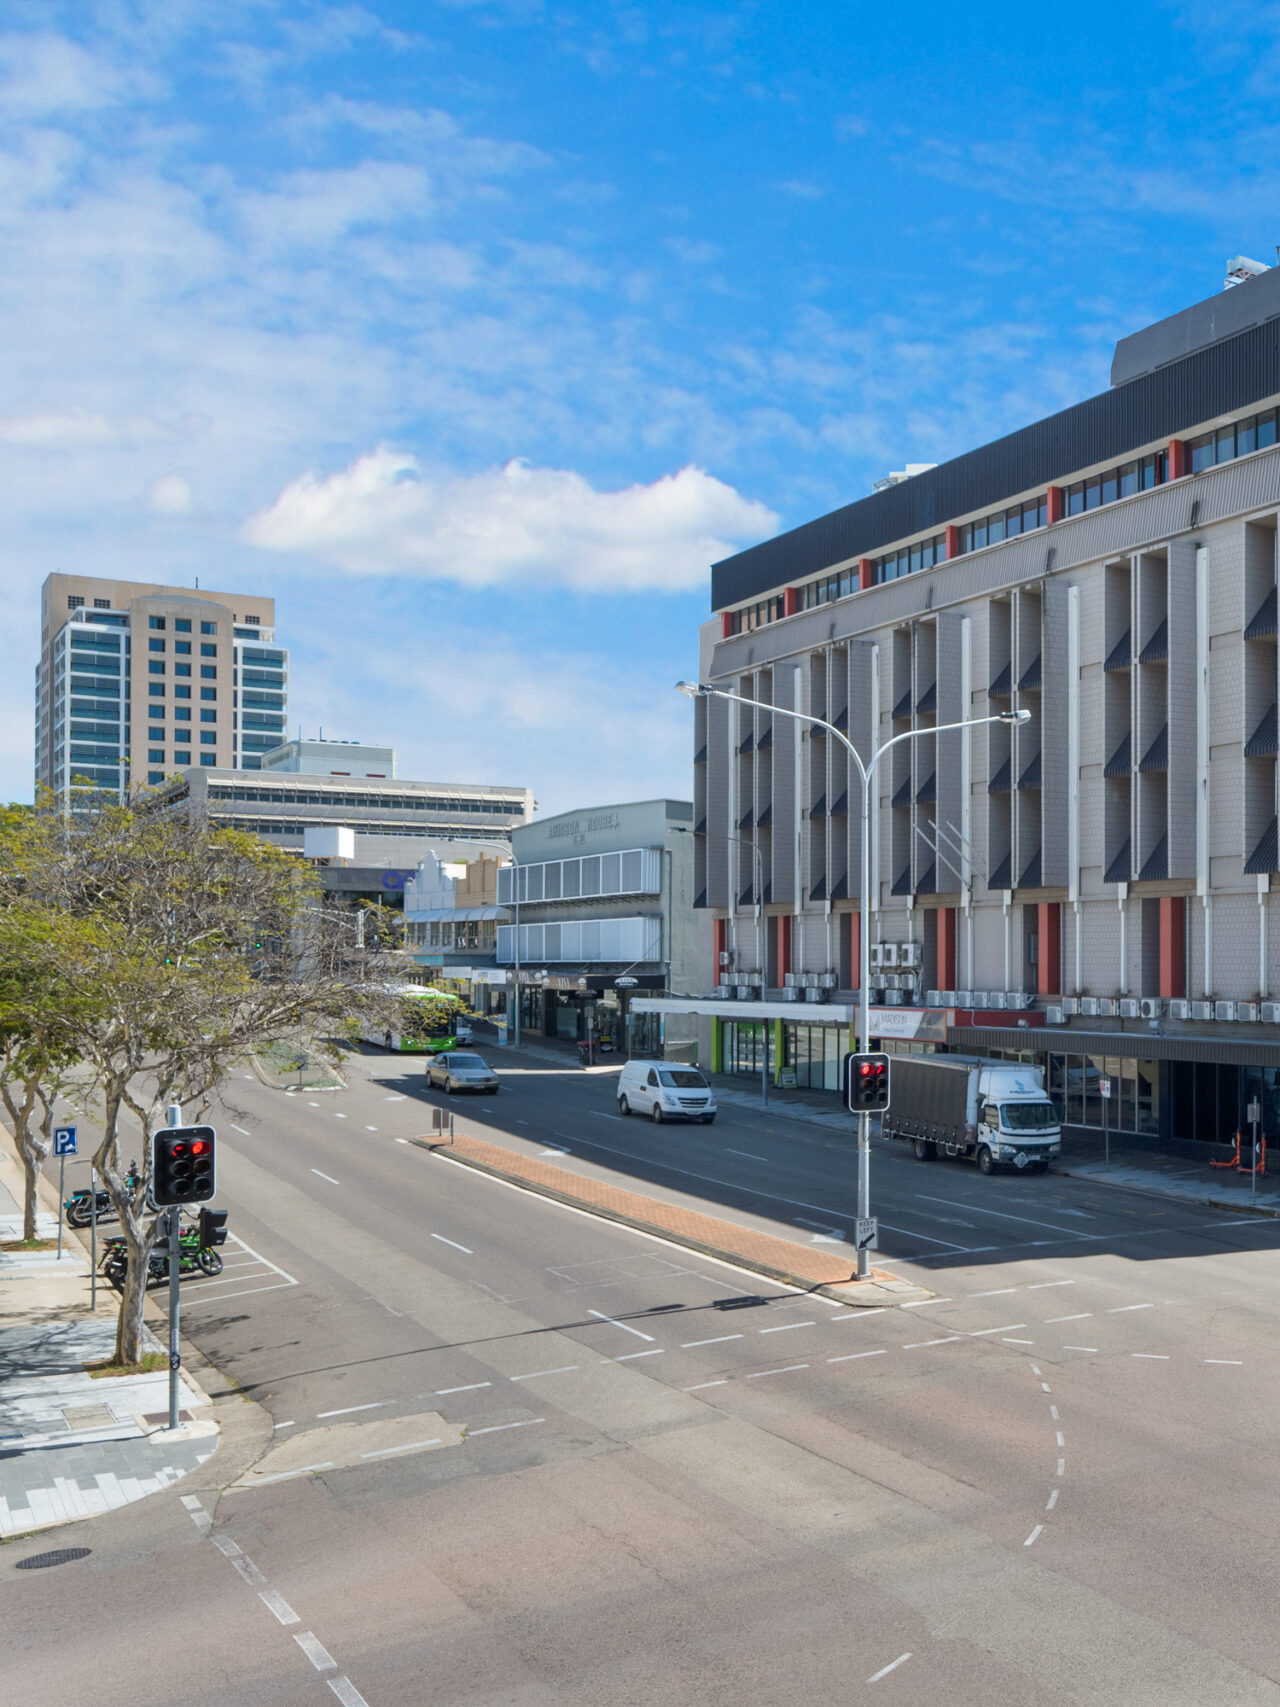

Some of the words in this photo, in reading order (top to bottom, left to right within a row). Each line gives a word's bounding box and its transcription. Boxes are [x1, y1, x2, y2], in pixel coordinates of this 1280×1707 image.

[587, 815, 613, 833] HOUSE
[881, 1014, 908, 1025] MADISON
[57, 1131, 70, 1153] P
